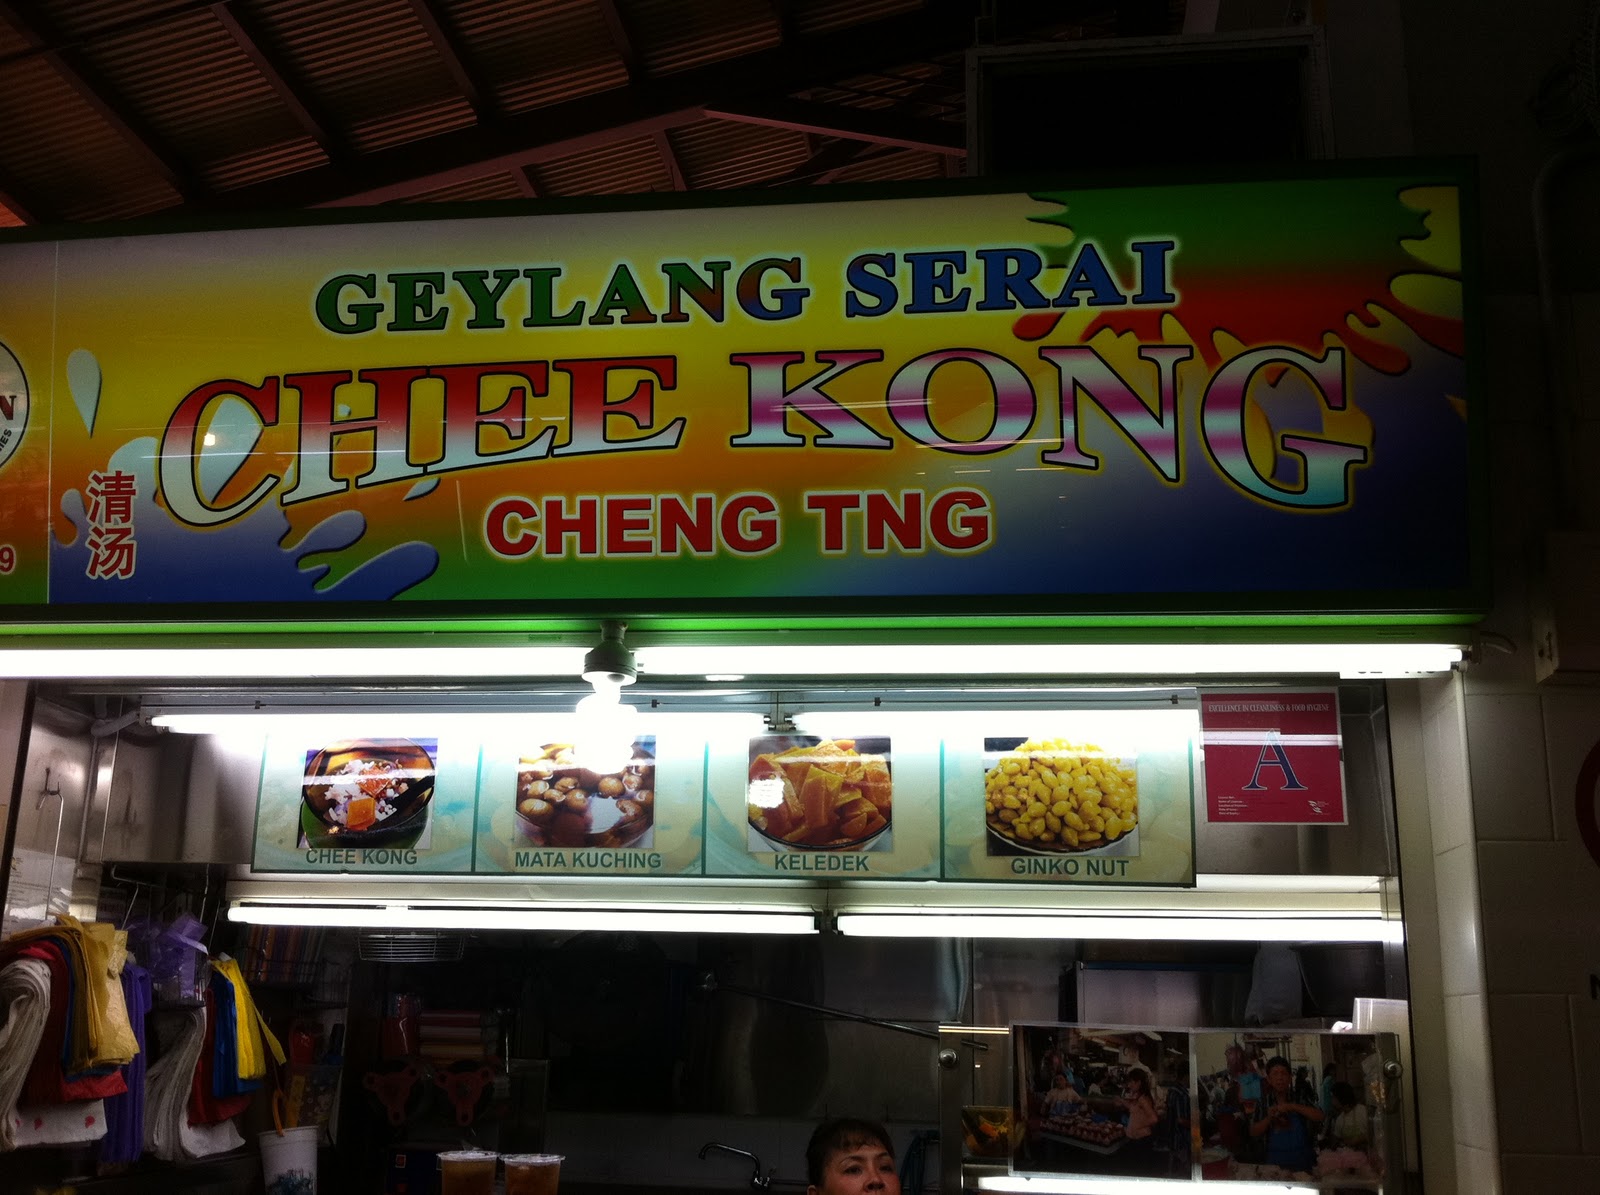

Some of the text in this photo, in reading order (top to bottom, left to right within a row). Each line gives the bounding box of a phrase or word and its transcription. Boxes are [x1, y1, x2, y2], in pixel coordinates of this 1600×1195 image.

[314, 239, 1178, 335] GEYLANG SERAI
[158, 344, 1368, 527] CHEE KONG
[86, 470, 136, 578] 清汤
[485, 489, 991, 560] CHENG TNG
[1208, 703, 1330, 713] EXCELLENCE IN CLEANLINESS & FOOD HYGIENE
[1242, 728, 1309, 790] A
[305, 849, 418, 866] CHEE KONG
[514, 851, 662, 869] MATA KUCHING
[774, 854, 870, 872] KELEDEK
[1010, 857, 1130, 877] GINKO NUT
